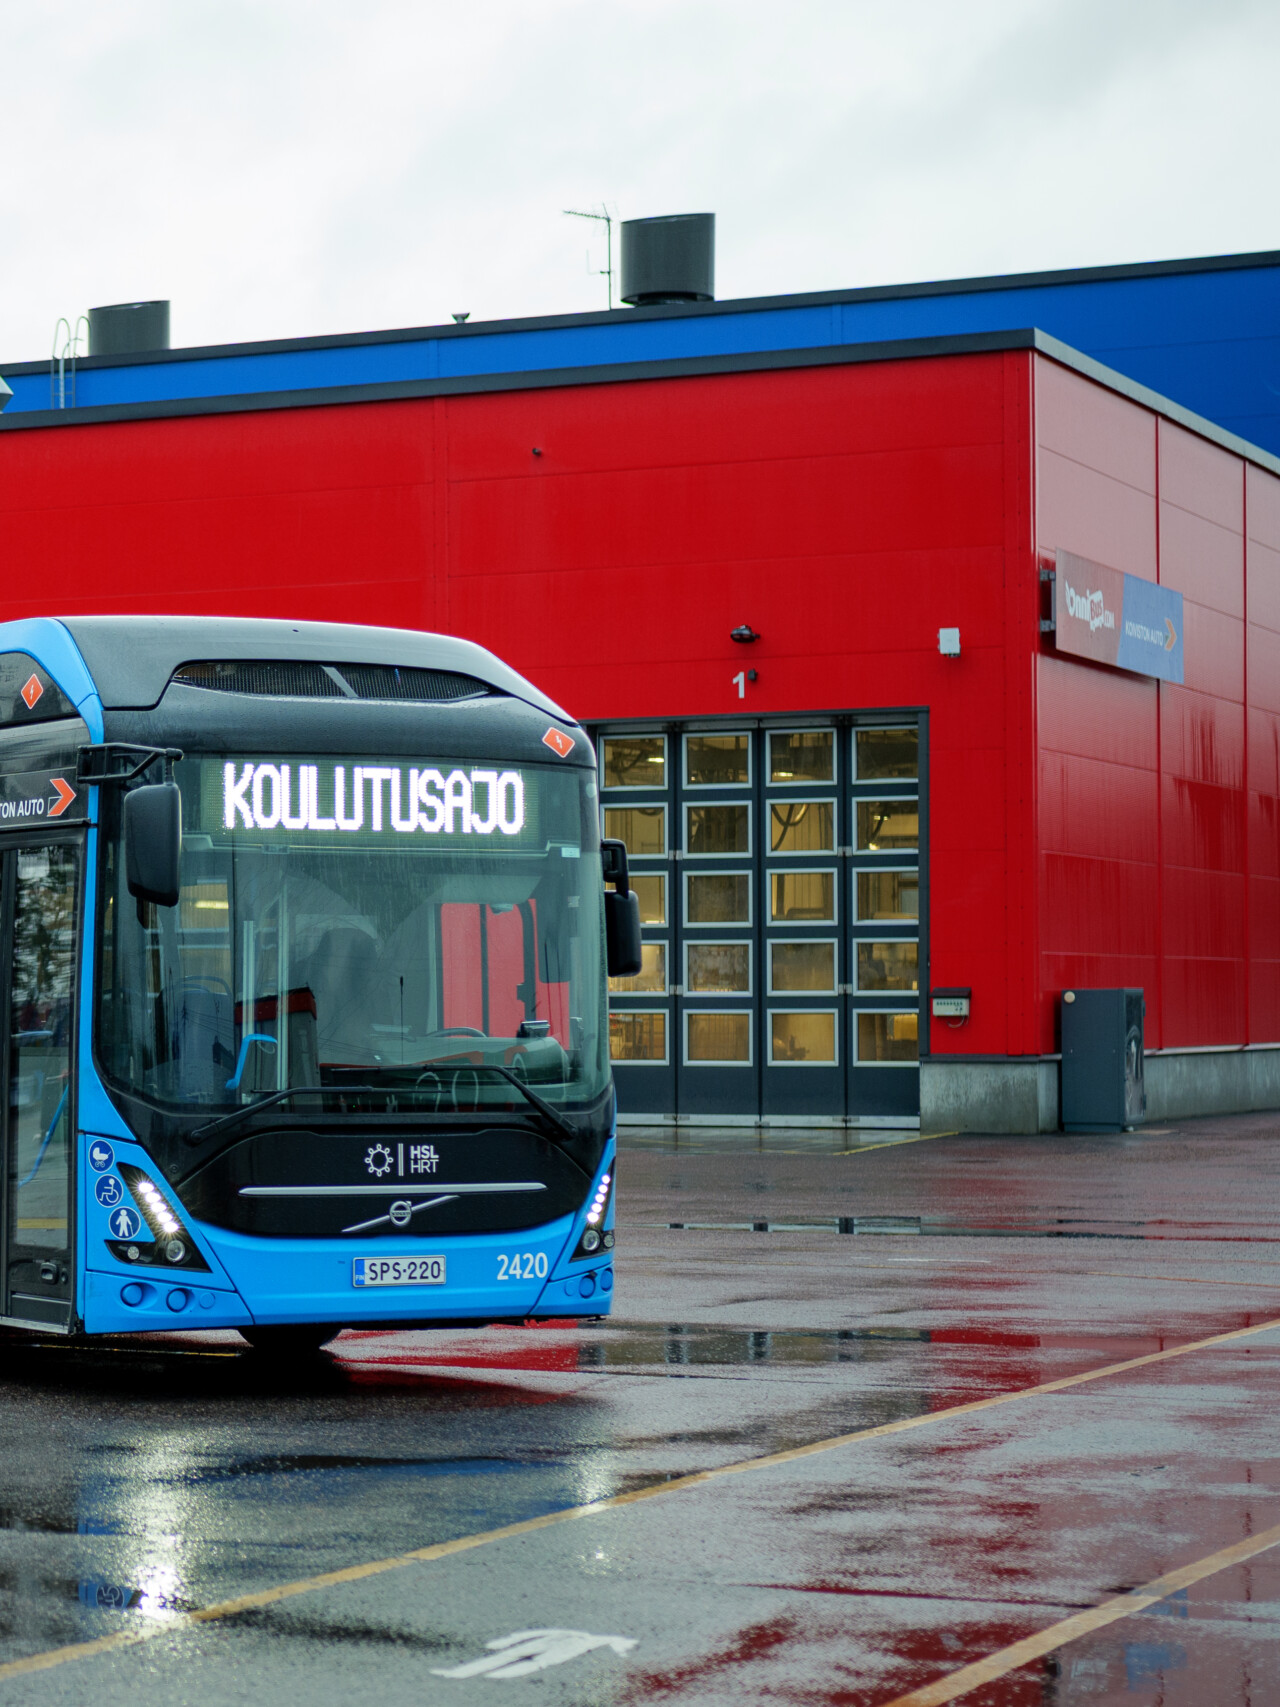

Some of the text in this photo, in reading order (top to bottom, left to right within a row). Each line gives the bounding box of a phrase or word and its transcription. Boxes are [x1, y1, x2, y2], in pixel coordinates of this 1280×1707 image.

[1151, 628, 1164, 646] AUTO
[732, 671, 745, 699] 1
[17, 798, 45, 816] AUTO
[223, 762, 524, 834] KOULUTUSAJO
[410, 1145, 439, 1159] HSL
[410, 1160, 439, 1173] HRT
[368, 1261, 441, 1281] SPS-220
[497, 1252, 548, 1280] 2420
